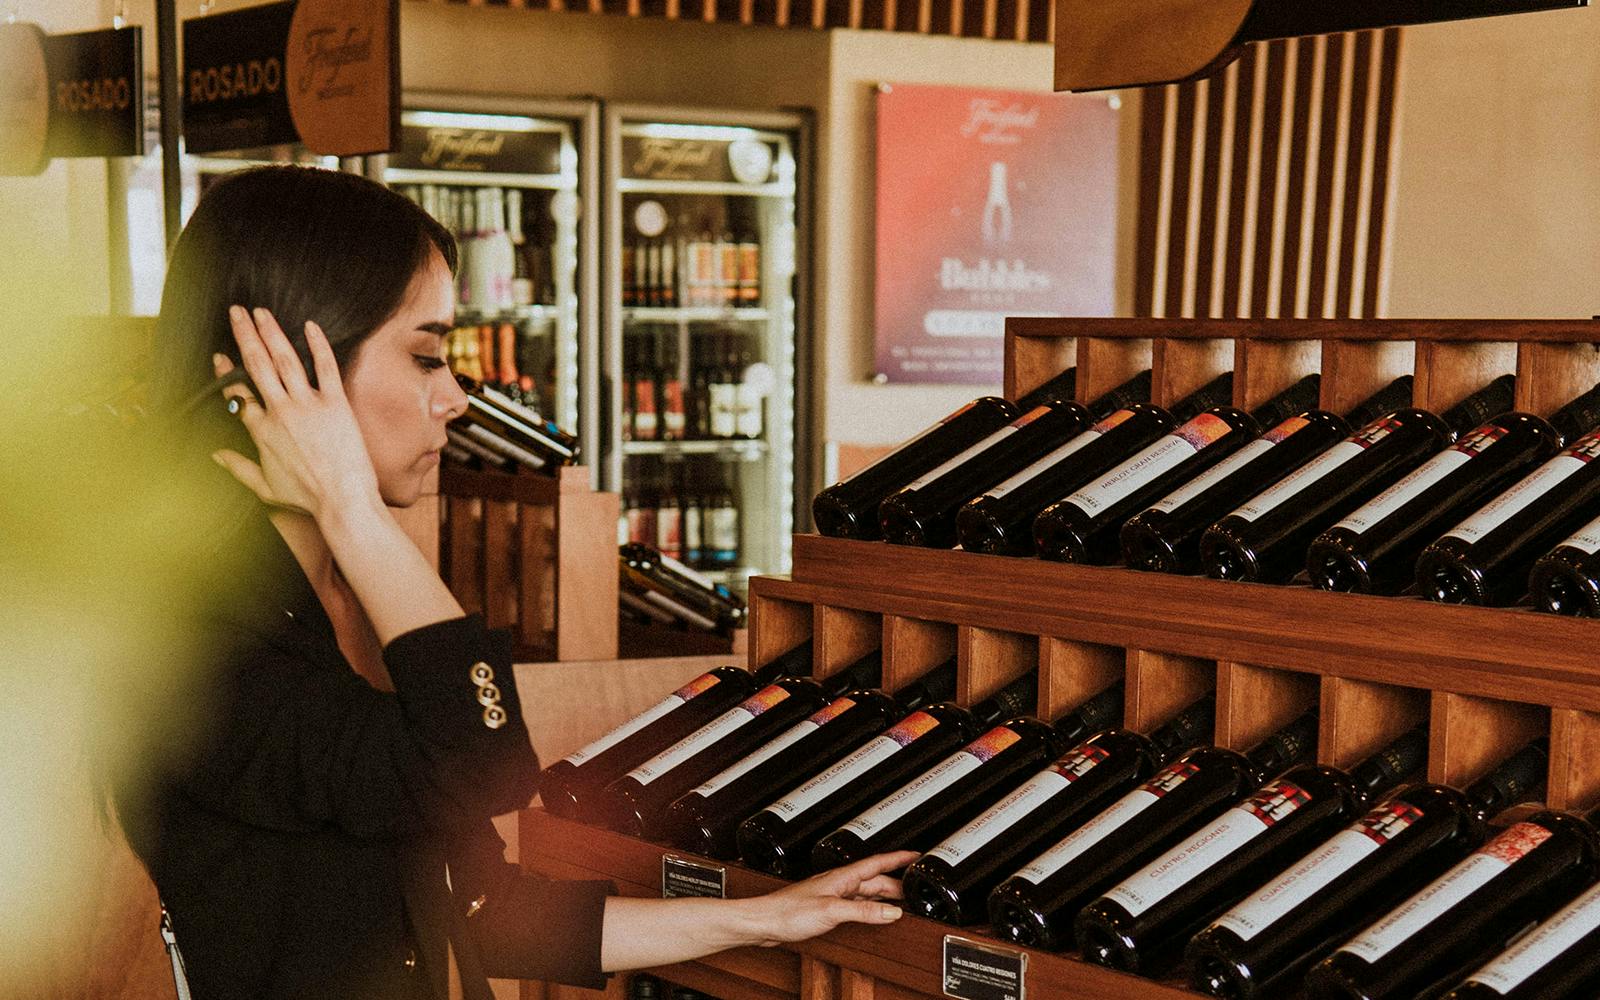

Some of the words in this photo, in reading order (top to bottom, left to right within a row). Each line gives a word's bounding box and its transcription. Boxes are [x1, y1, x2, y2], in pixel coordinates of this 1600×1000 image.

[56, 79, 129, 111] ROSADO
[189, 57, 281, 102] ROSADO
[1101, 469, 1129, 490] MERLOT
[1129, 456, 1151, 472] GRAN
[1150, 438, 1179, 459] RESERVA
[799, 772, 831, 794] MERLOT
[831, 757, 854, 774] GRAN
[853, 737, 886, 760] RESERVA
[877, 789, 909, 812] MERLOT
[909, 773, 933, 791] GRAN
[932, 752, 967, 777] RESERVA
[965, 809, 999, 835] CUATRO
[997, 782, 1036, 812] REGIONES
[1149, 851, 1187, 880] CUATRO
[1185, 822, 1230, 856] REGIONES
[1258, 874, 1297, 903] CUATRO
[1294, 843, 1341, 878] REGIONES
[1419, 882, 1446, 903] GRAN
[961, 959, 980, 970] DOLORES
[980, 964, 996, 974] CUATRO
[995, 967, 1017, 979] REGIONES
